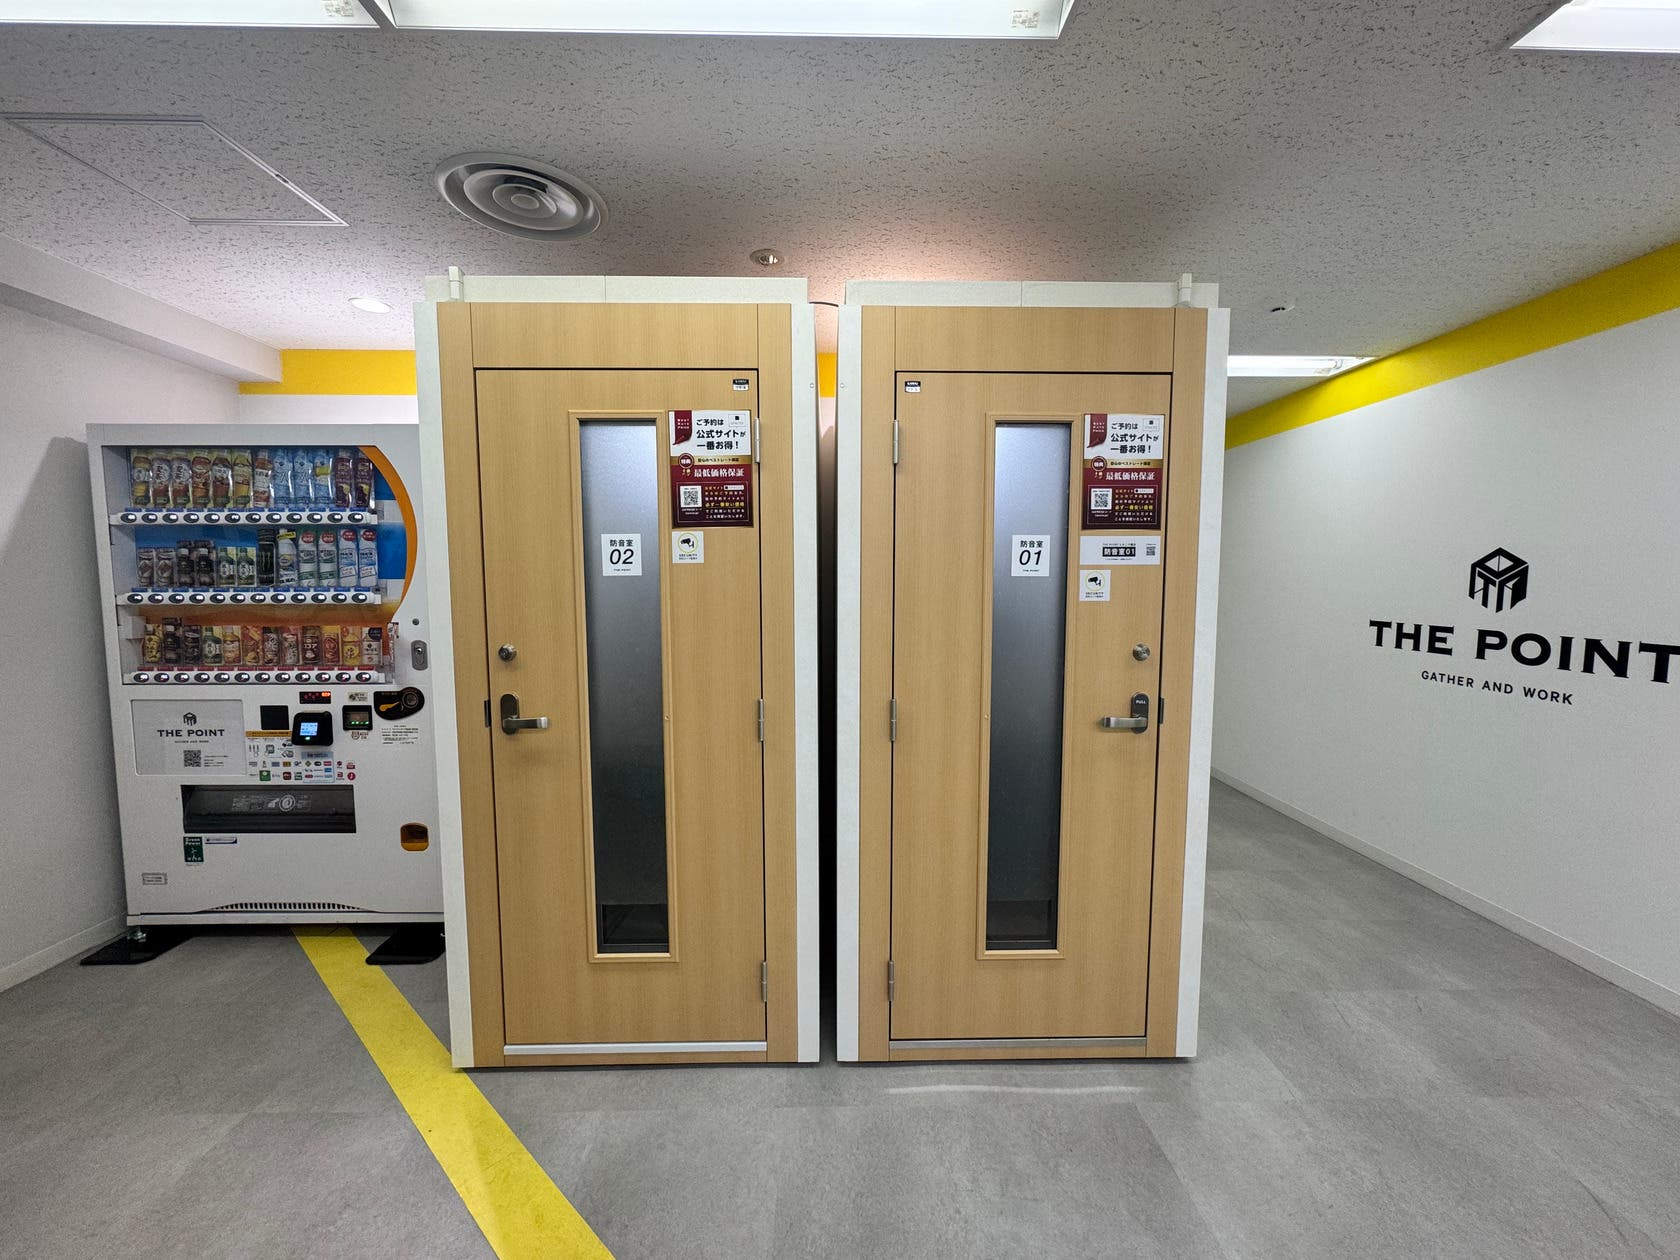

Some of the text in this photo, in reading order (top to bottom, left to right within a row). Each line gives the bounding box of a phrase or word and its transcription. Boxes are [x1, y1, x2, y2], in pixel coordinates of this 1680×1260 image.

[696, 430, 746, 438] 公式サイトが
[1110, 433, 1159, 442] 公式サイトが
[694, 468, 744, 478] 最低価格保証
[1106, 472, 1155, 481] 最低価格保証
[610, 539, 634, 547] 防音室
[1020, 540, 1044, 548] 防音室
[609, 548, 634, 565] 02
[1019, 549, 1042, 566] 01
[1369, 619, 1680, 684] THE POINT
[1421, 670, 1574, 706] GATHER AND WORK
